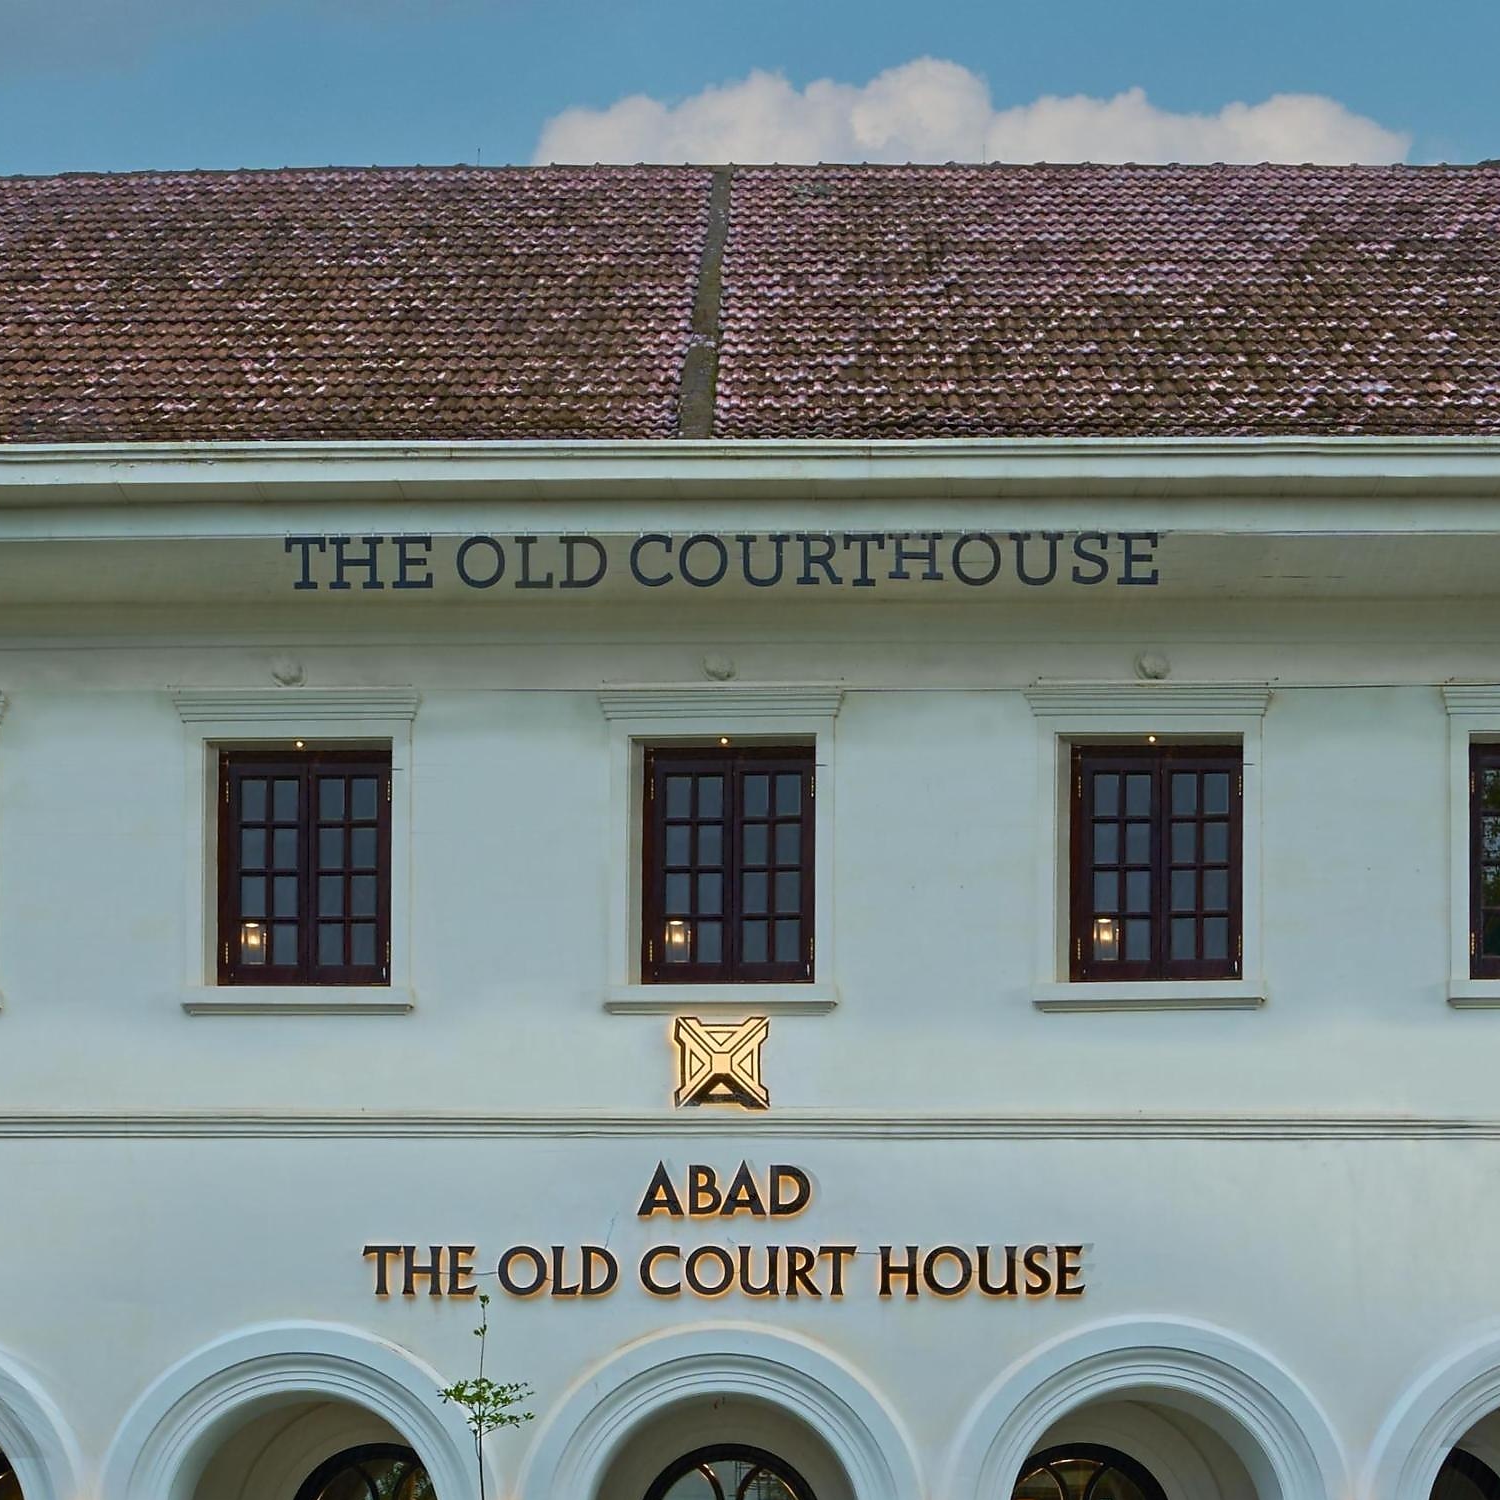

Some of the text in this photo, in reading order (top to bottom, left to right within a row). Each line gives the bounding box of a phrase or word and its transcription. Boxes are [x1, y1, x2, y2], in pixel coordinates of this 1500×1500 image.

[285, 532, 1160, 590] THE OLD COURTHOUSE
[636, 1160, 811, 1217] ABAD
[362, 1244, 1086, 1297] THE OLD COURT HOUSE
